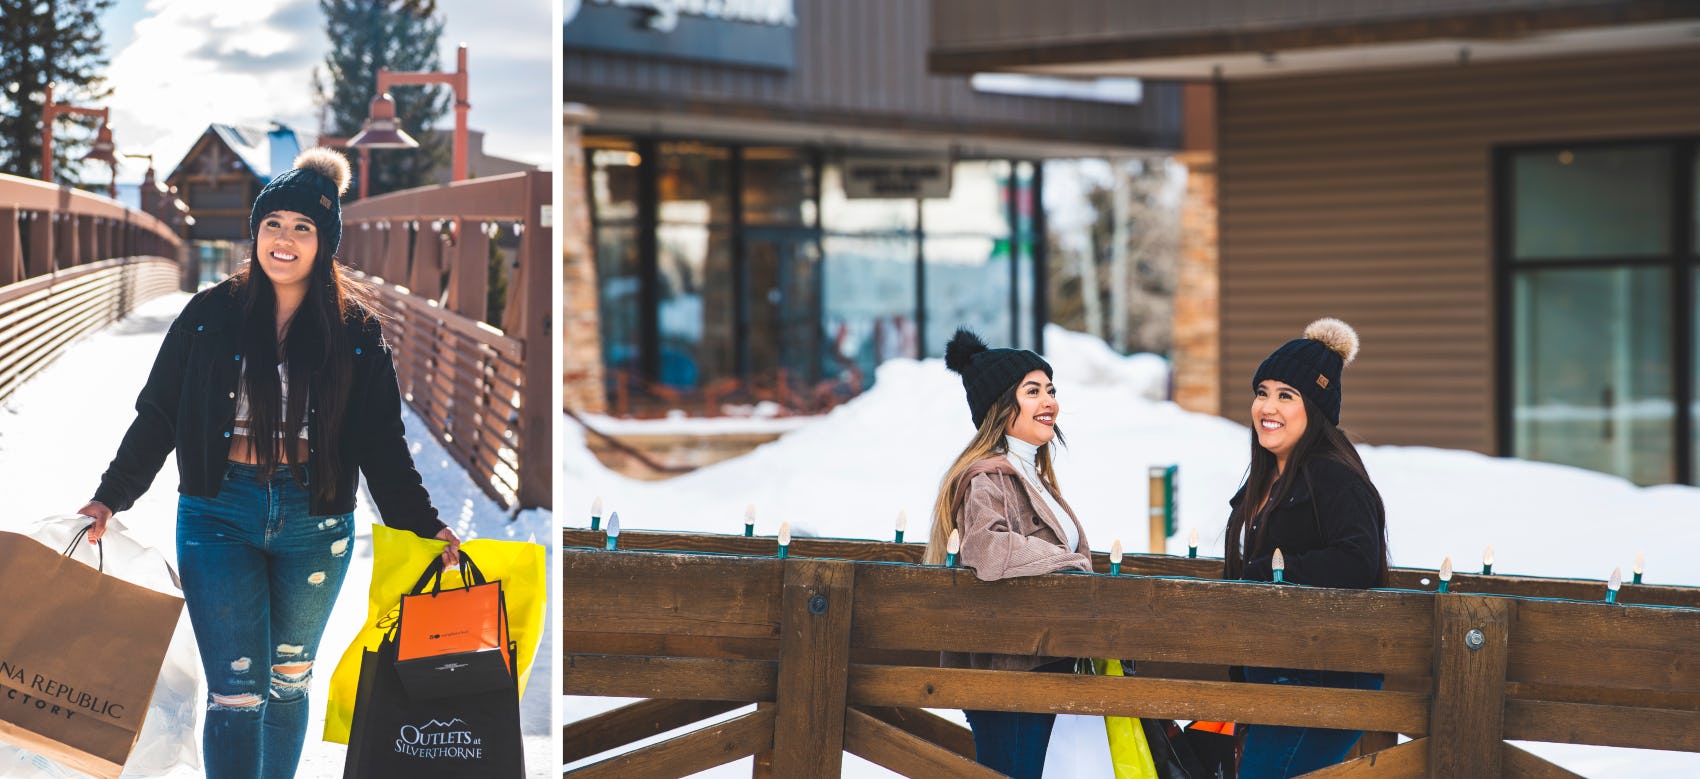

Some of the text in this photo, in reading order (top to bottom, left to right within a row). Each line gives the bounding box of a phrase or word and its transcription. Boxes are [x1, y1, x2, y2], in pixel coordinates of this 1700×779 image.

[31, 673, 124, 718] REPUBLIC
[400, 724, 471, 745] OUTLETS
[395, 739, 482, 759] SILVERTHORNE
